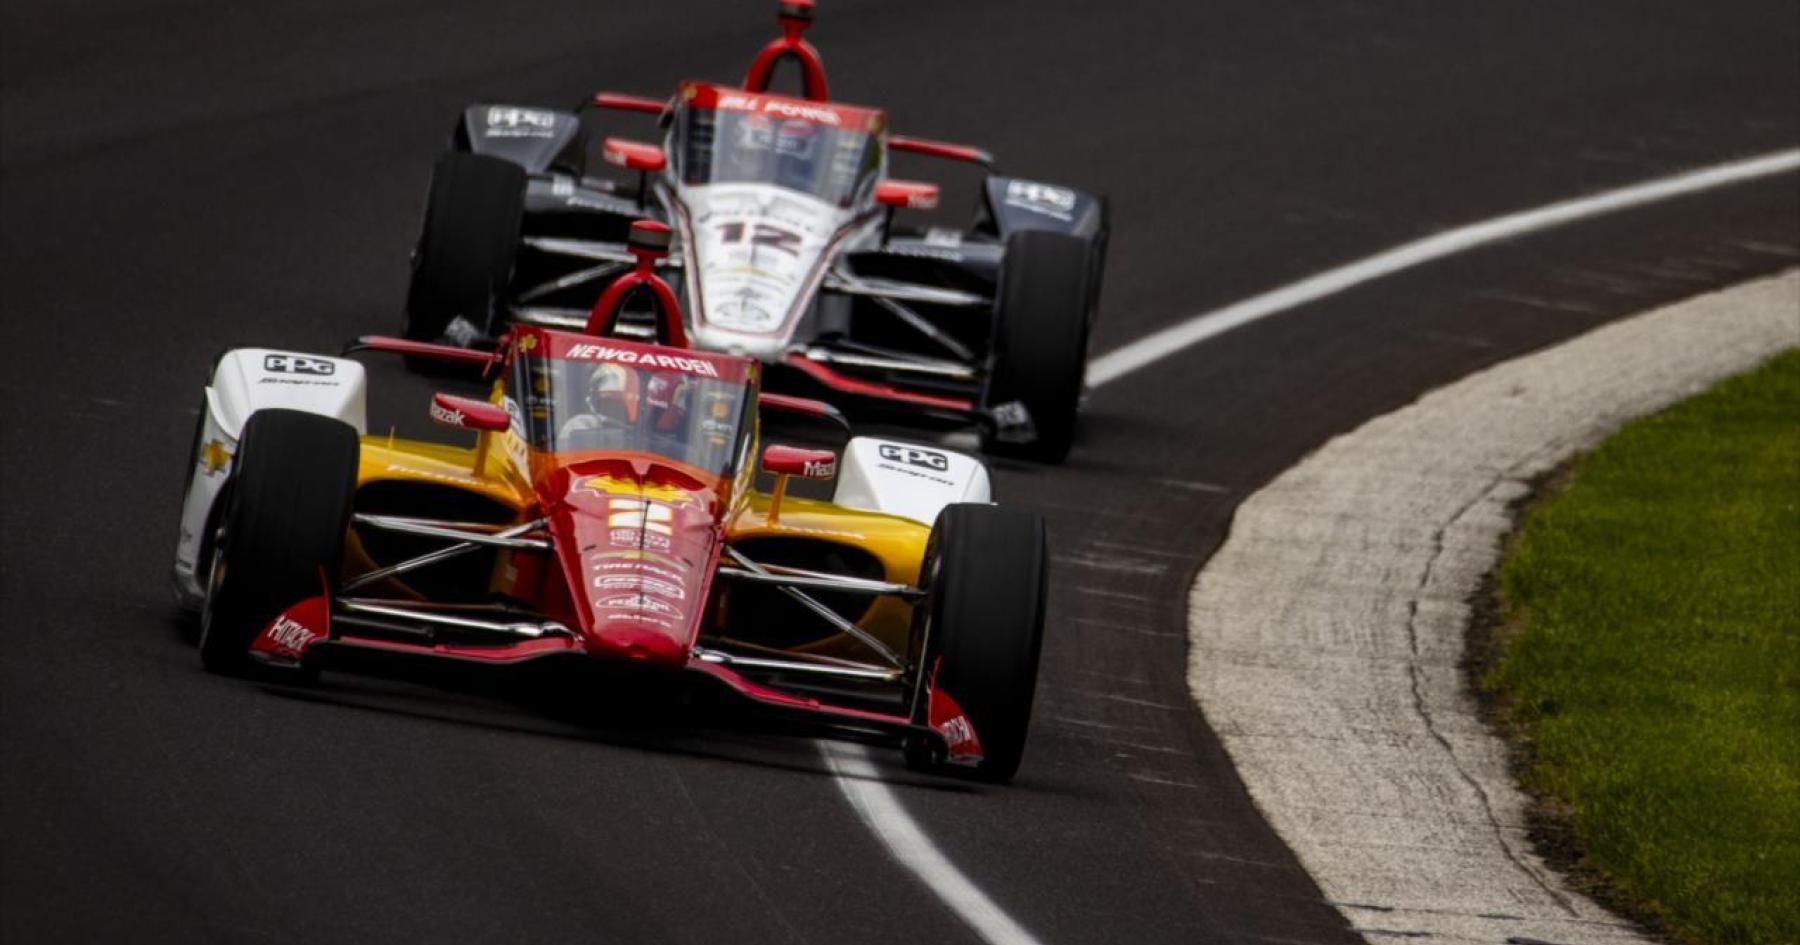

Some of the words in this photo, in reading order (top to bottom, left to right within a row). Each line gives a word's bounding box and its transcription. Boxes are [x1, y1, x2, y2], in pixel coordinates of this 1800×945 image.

[714, 221, 803, 258] 12
[266, 356, 334, 375] PPG
[566, 343, 719, 378] NEWGARDEN
[880, 446, 947, 470] PPG
[608, 499, 672, 536] 2
[591, 562, 633, 571] TIRE
